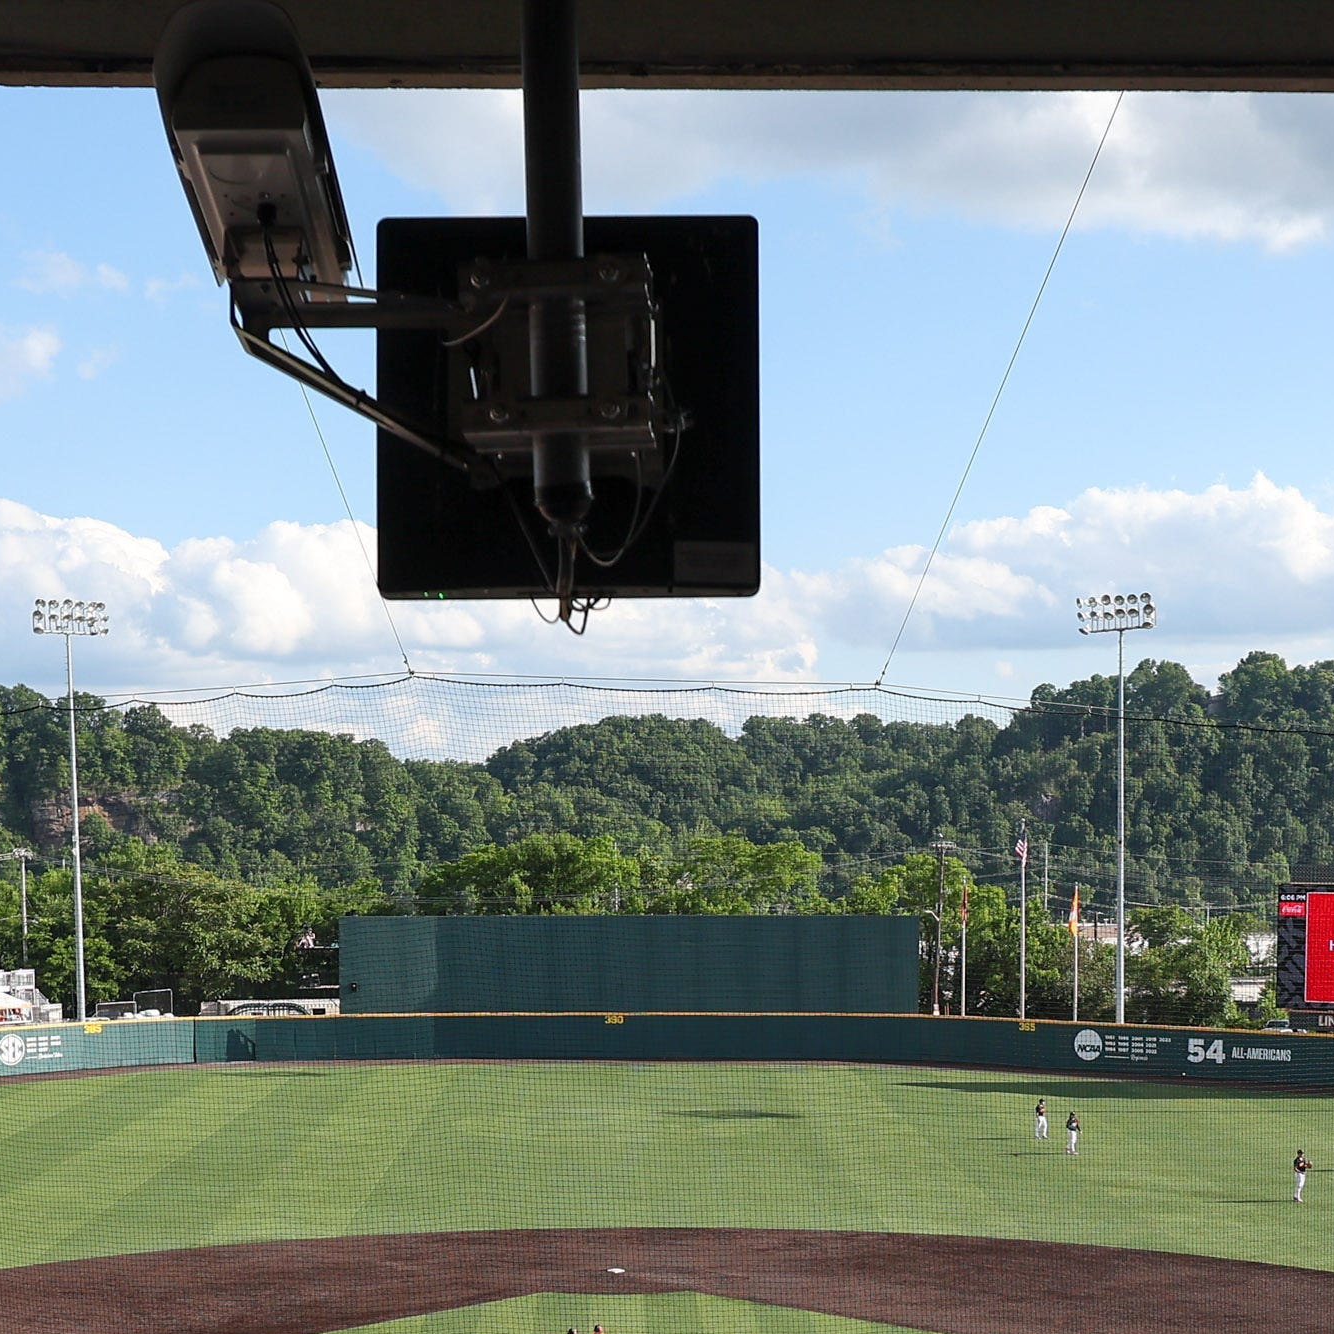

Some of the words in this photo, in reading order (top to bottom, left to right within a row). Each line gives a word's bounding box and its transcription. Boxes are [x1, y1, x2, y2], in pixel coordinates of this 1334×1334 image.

[1018, 1022, 1036, 1032] 365
[1186, 1037, 1226, 1064] 54
[1231, 1046, 1292, 1062] ALL-AMERICANS
